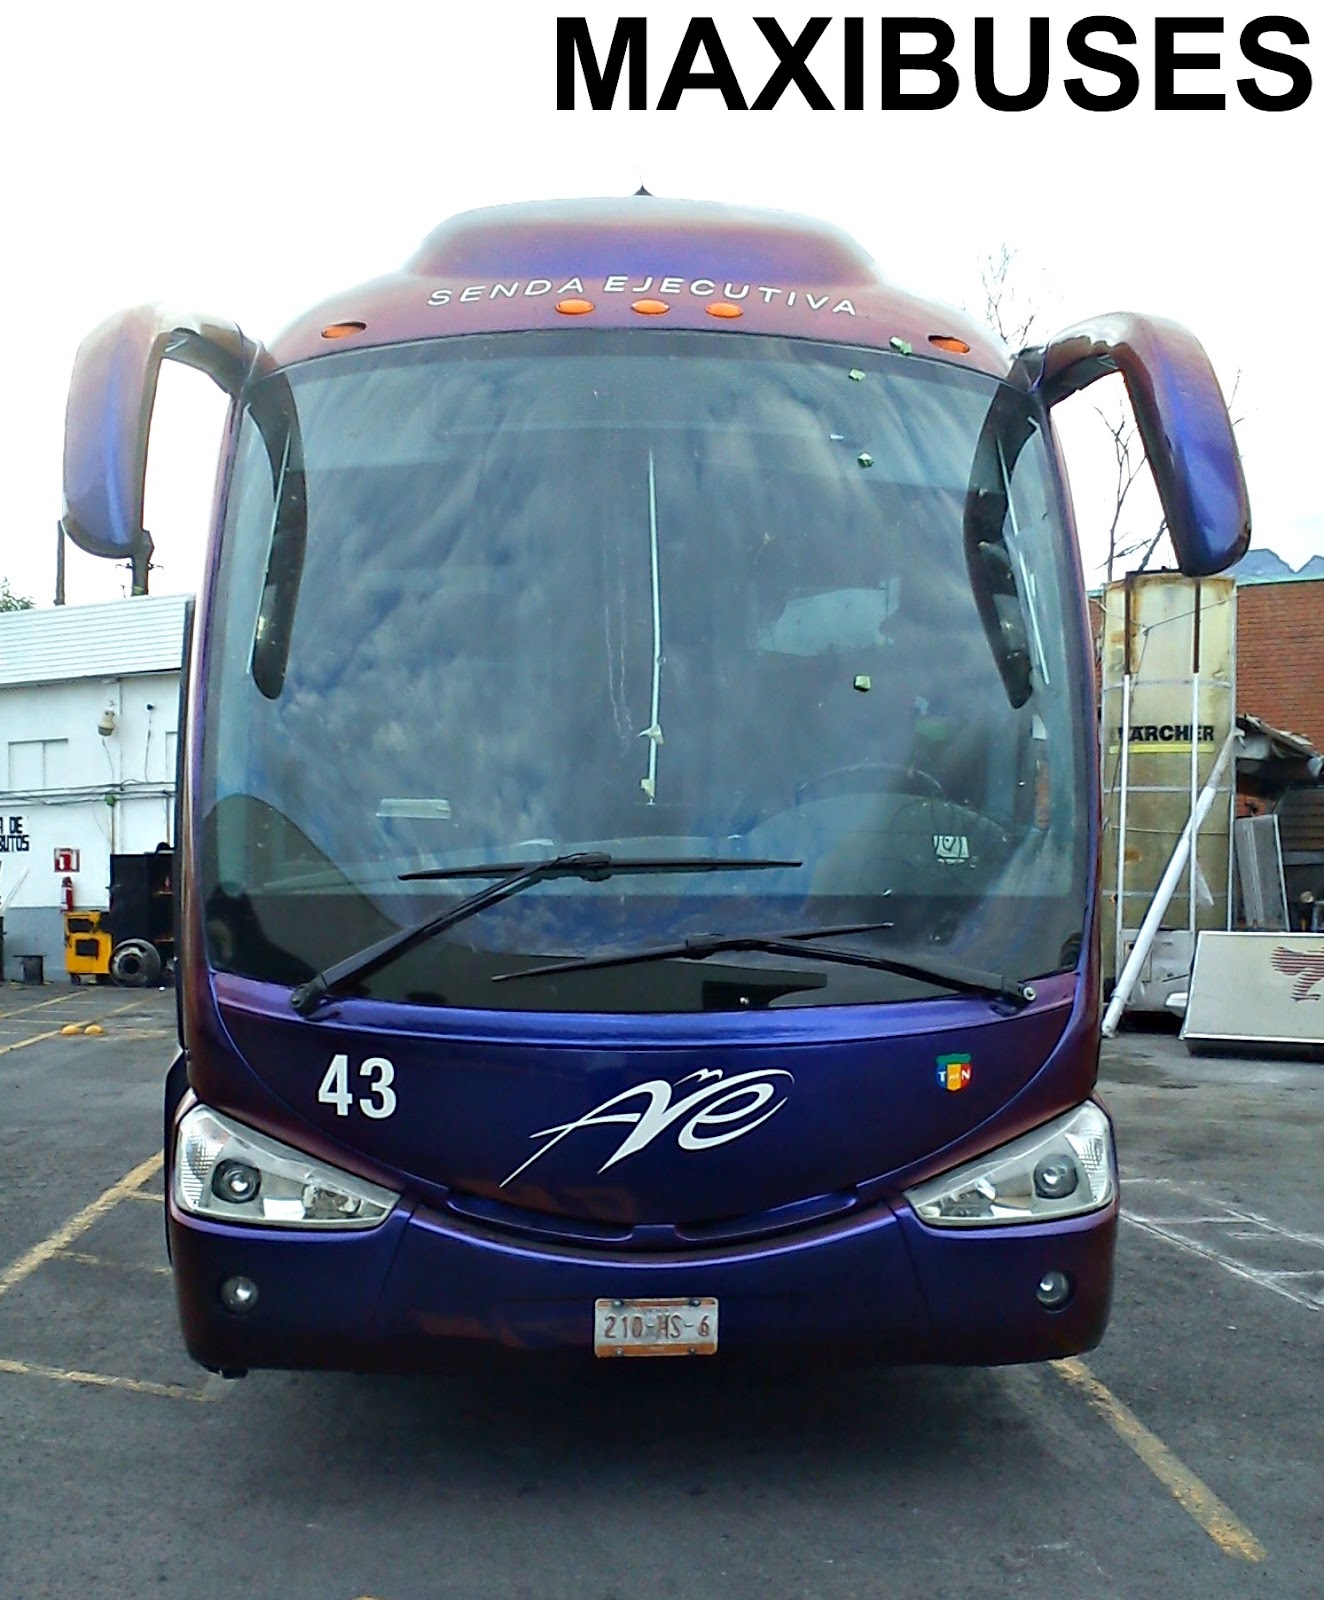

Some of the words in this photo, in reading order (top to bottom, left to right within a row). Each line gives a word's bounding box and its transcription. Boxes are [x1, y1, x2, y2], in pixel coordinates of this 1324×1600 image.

[427, 277, 584, 306] SENDA
[603, 276, 857, 316] EJECUTIVA
[9, 816, 23, 834] DE
[318, 1053, 397, 1119] 43
